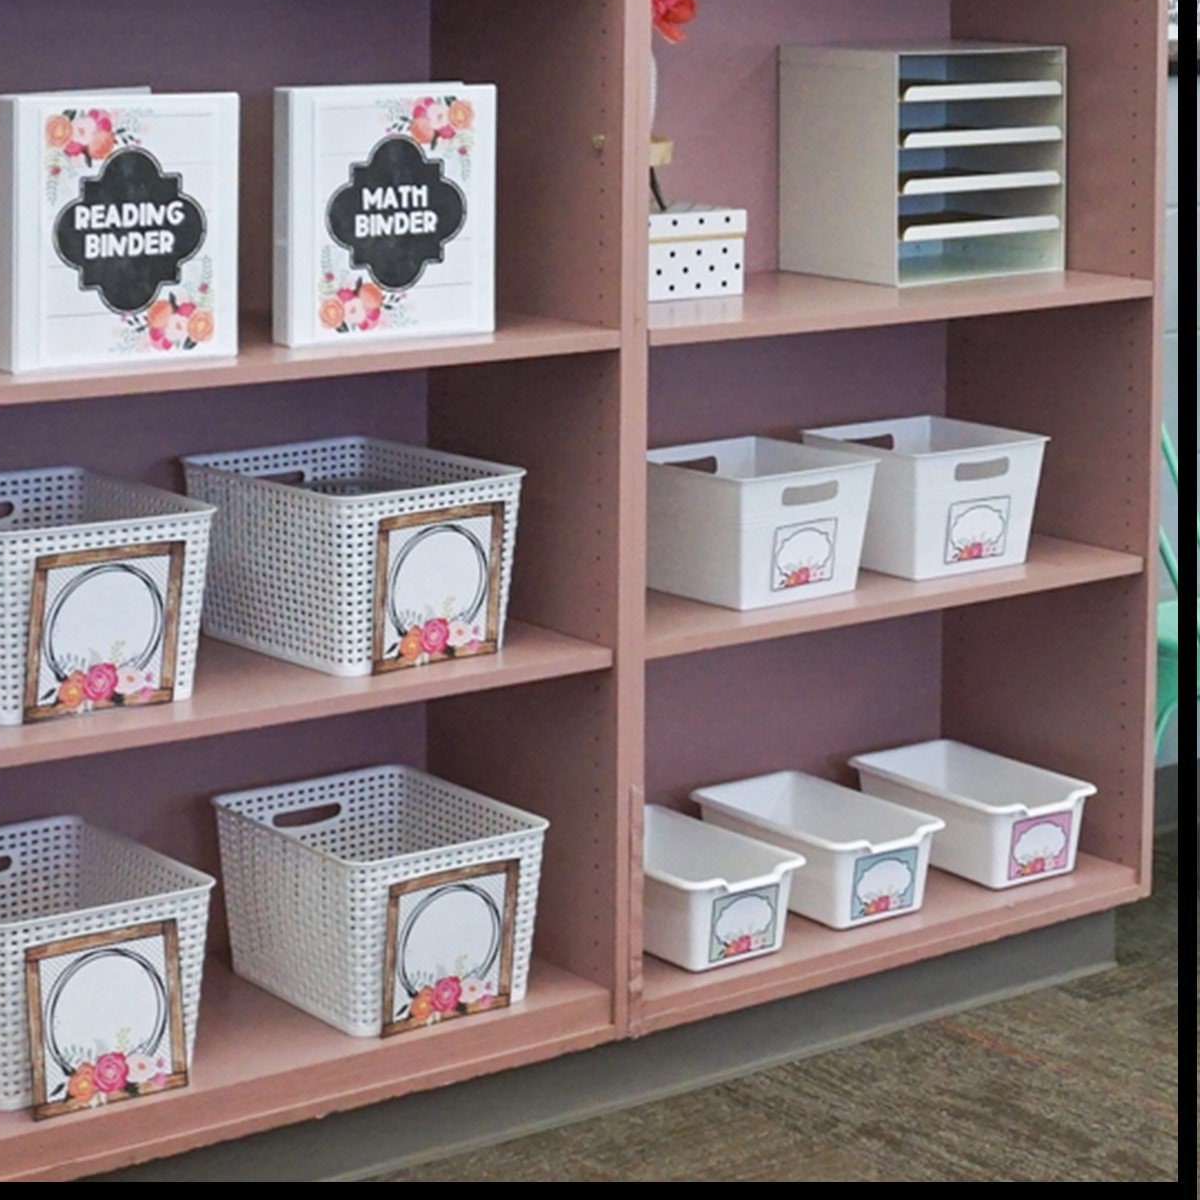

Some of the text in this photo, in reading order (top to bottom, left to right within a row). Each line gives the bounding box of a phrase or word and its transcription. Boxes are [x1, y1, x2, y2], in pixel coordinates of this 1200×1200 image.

[362, 185, 428, 211] MATH
[74, 201, 185, 231] READING
[355, 210, 438, 238] BINDER
[84, 230, 176, 259] BINDER
